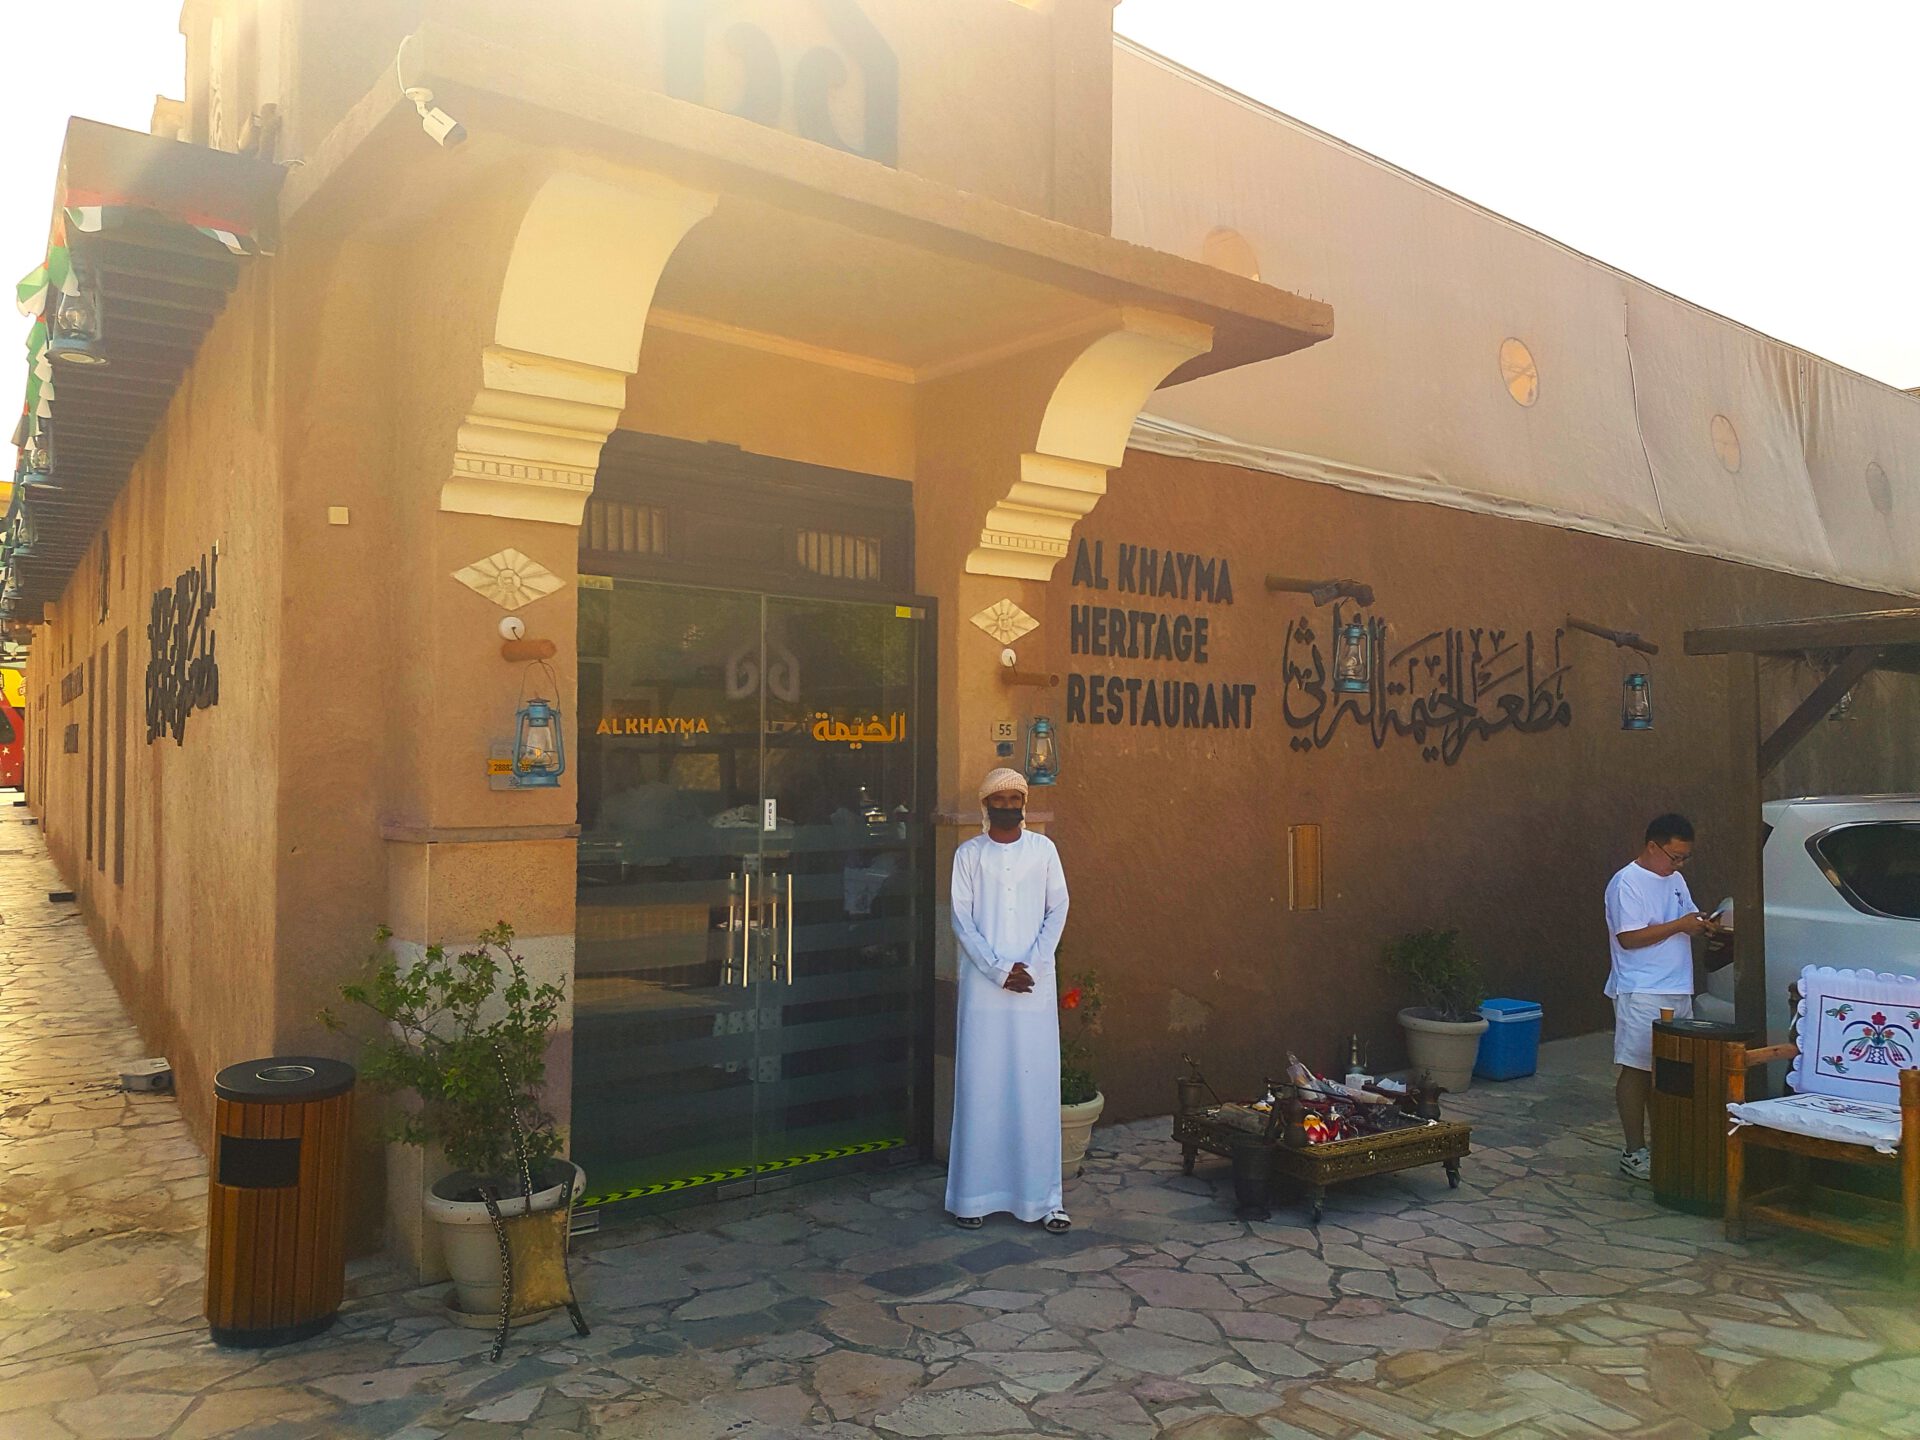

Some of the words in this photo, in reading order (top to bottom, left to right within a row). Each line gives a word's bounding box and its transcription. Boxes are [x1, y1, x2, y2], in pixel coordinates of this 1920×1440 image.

[1072, 538, 1109, 590] AL
[1118, 543, 1234, 605] KHAYMA
[1071, 604, 1209, 663] HERITAGE
[1066, 673, 1257, 729] RESTAURANT
[812, 711, 906, 750] الخيمة
[999, 723, 1012, 736] 55
